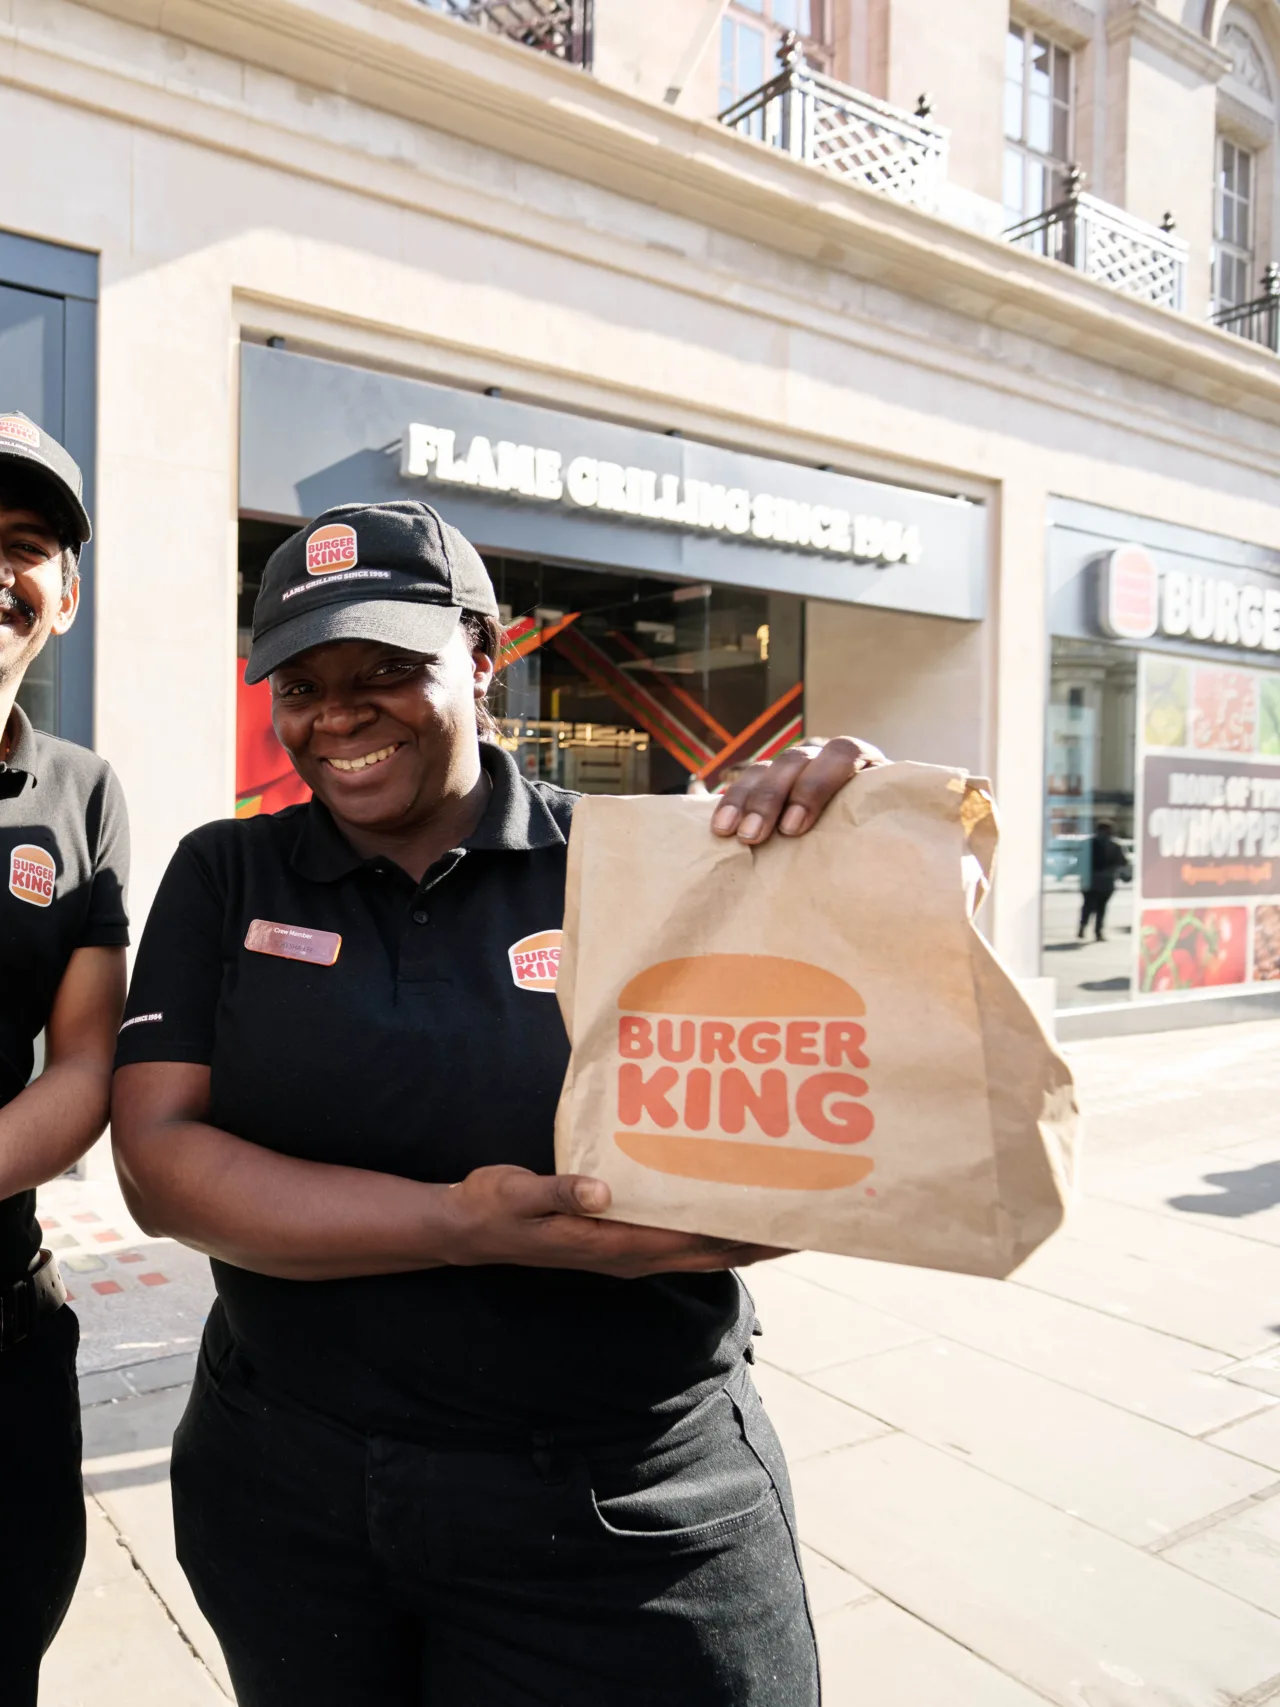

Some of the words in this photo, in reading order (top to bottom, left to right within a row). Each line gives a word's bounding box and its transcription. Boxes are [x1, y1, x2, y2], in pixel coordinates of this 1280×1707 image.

[408, 422, 563, 500] FLAME
[567, 455, 751, 534] GRILLING
[308, 537, 355, 553] BURGER
[308, 546, 355, 567] KING
[282, 585, 305, 600] FLAME
[305, 574, 343, 589] GRILLING
[343, 570, 369, 580] SINCE
[12, 869, 53, 897] KING
[13, 859, 54, 881] BURGER
[289, 929, 313, 939] Member
[617, 1016, 871, 1069] BURGER
[617, 1062, 876, 1145] KING
